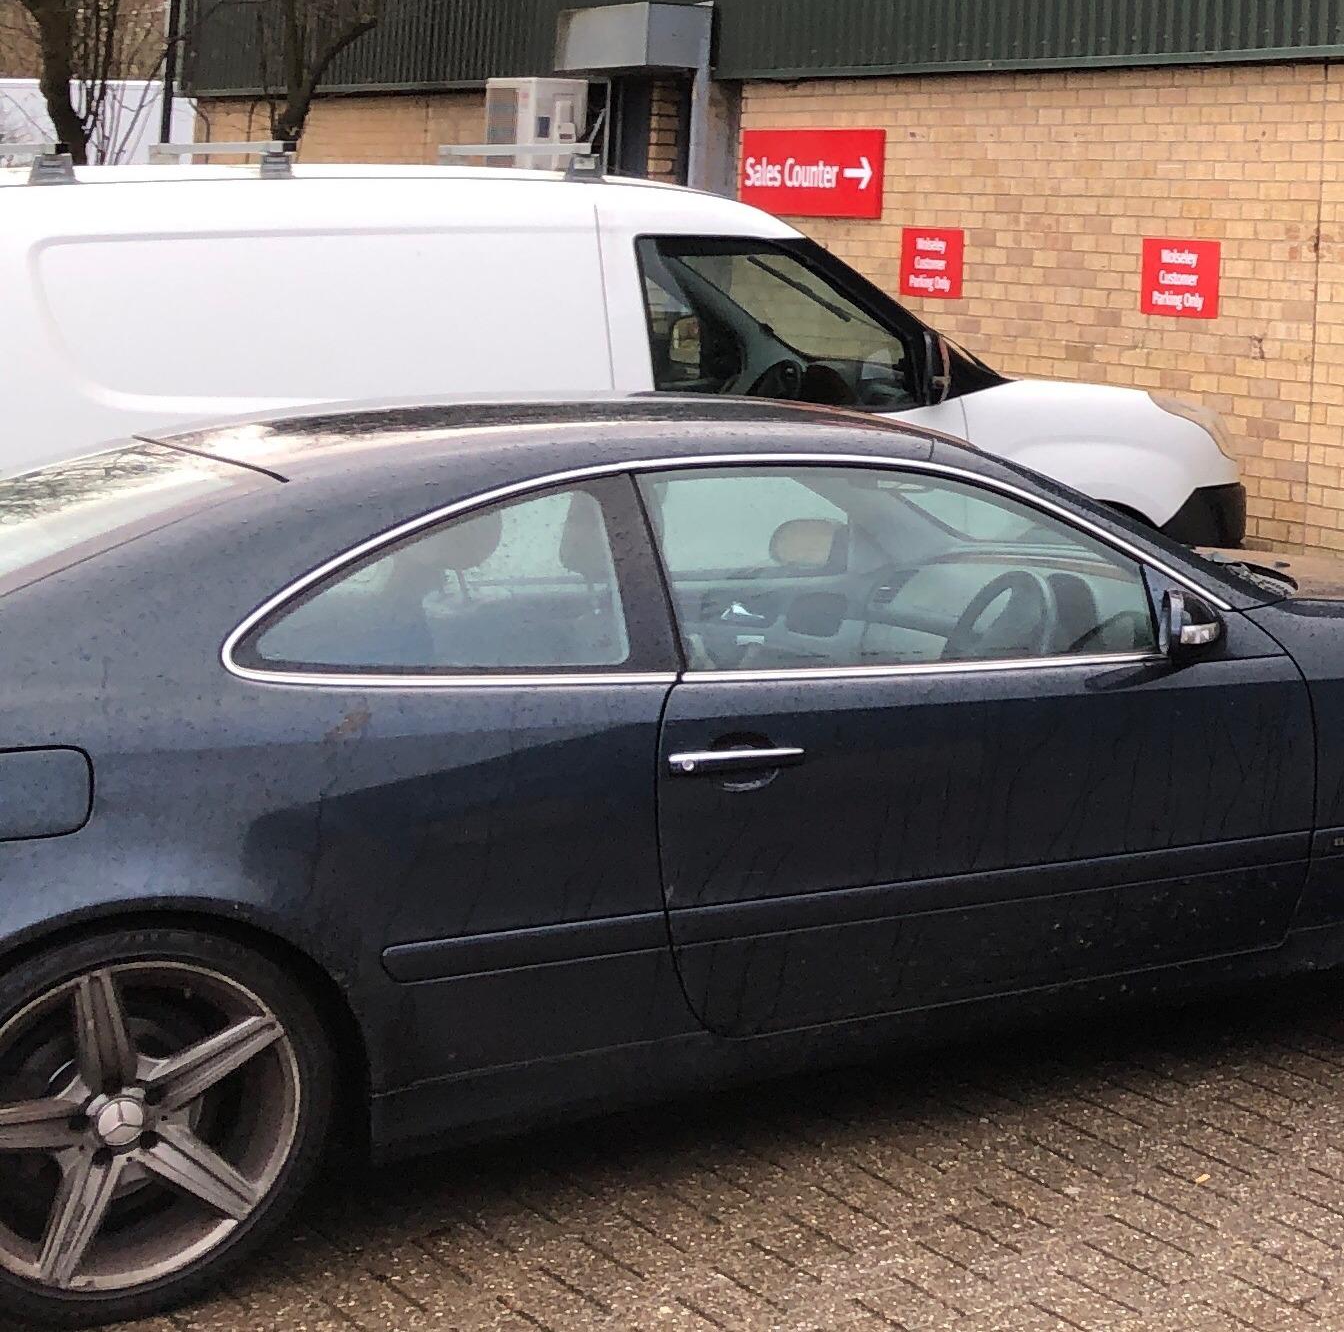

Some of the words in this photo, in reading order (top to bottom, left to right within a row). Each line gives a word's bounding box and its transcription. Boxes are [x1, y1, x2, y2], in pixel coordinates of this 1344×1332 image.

[744, 156, 782, 188] Sales
[784, 157, 840, 189] Counter
[1151, 290, 1183, 311] Parking
[1183, 292, 1205, 311] Only
